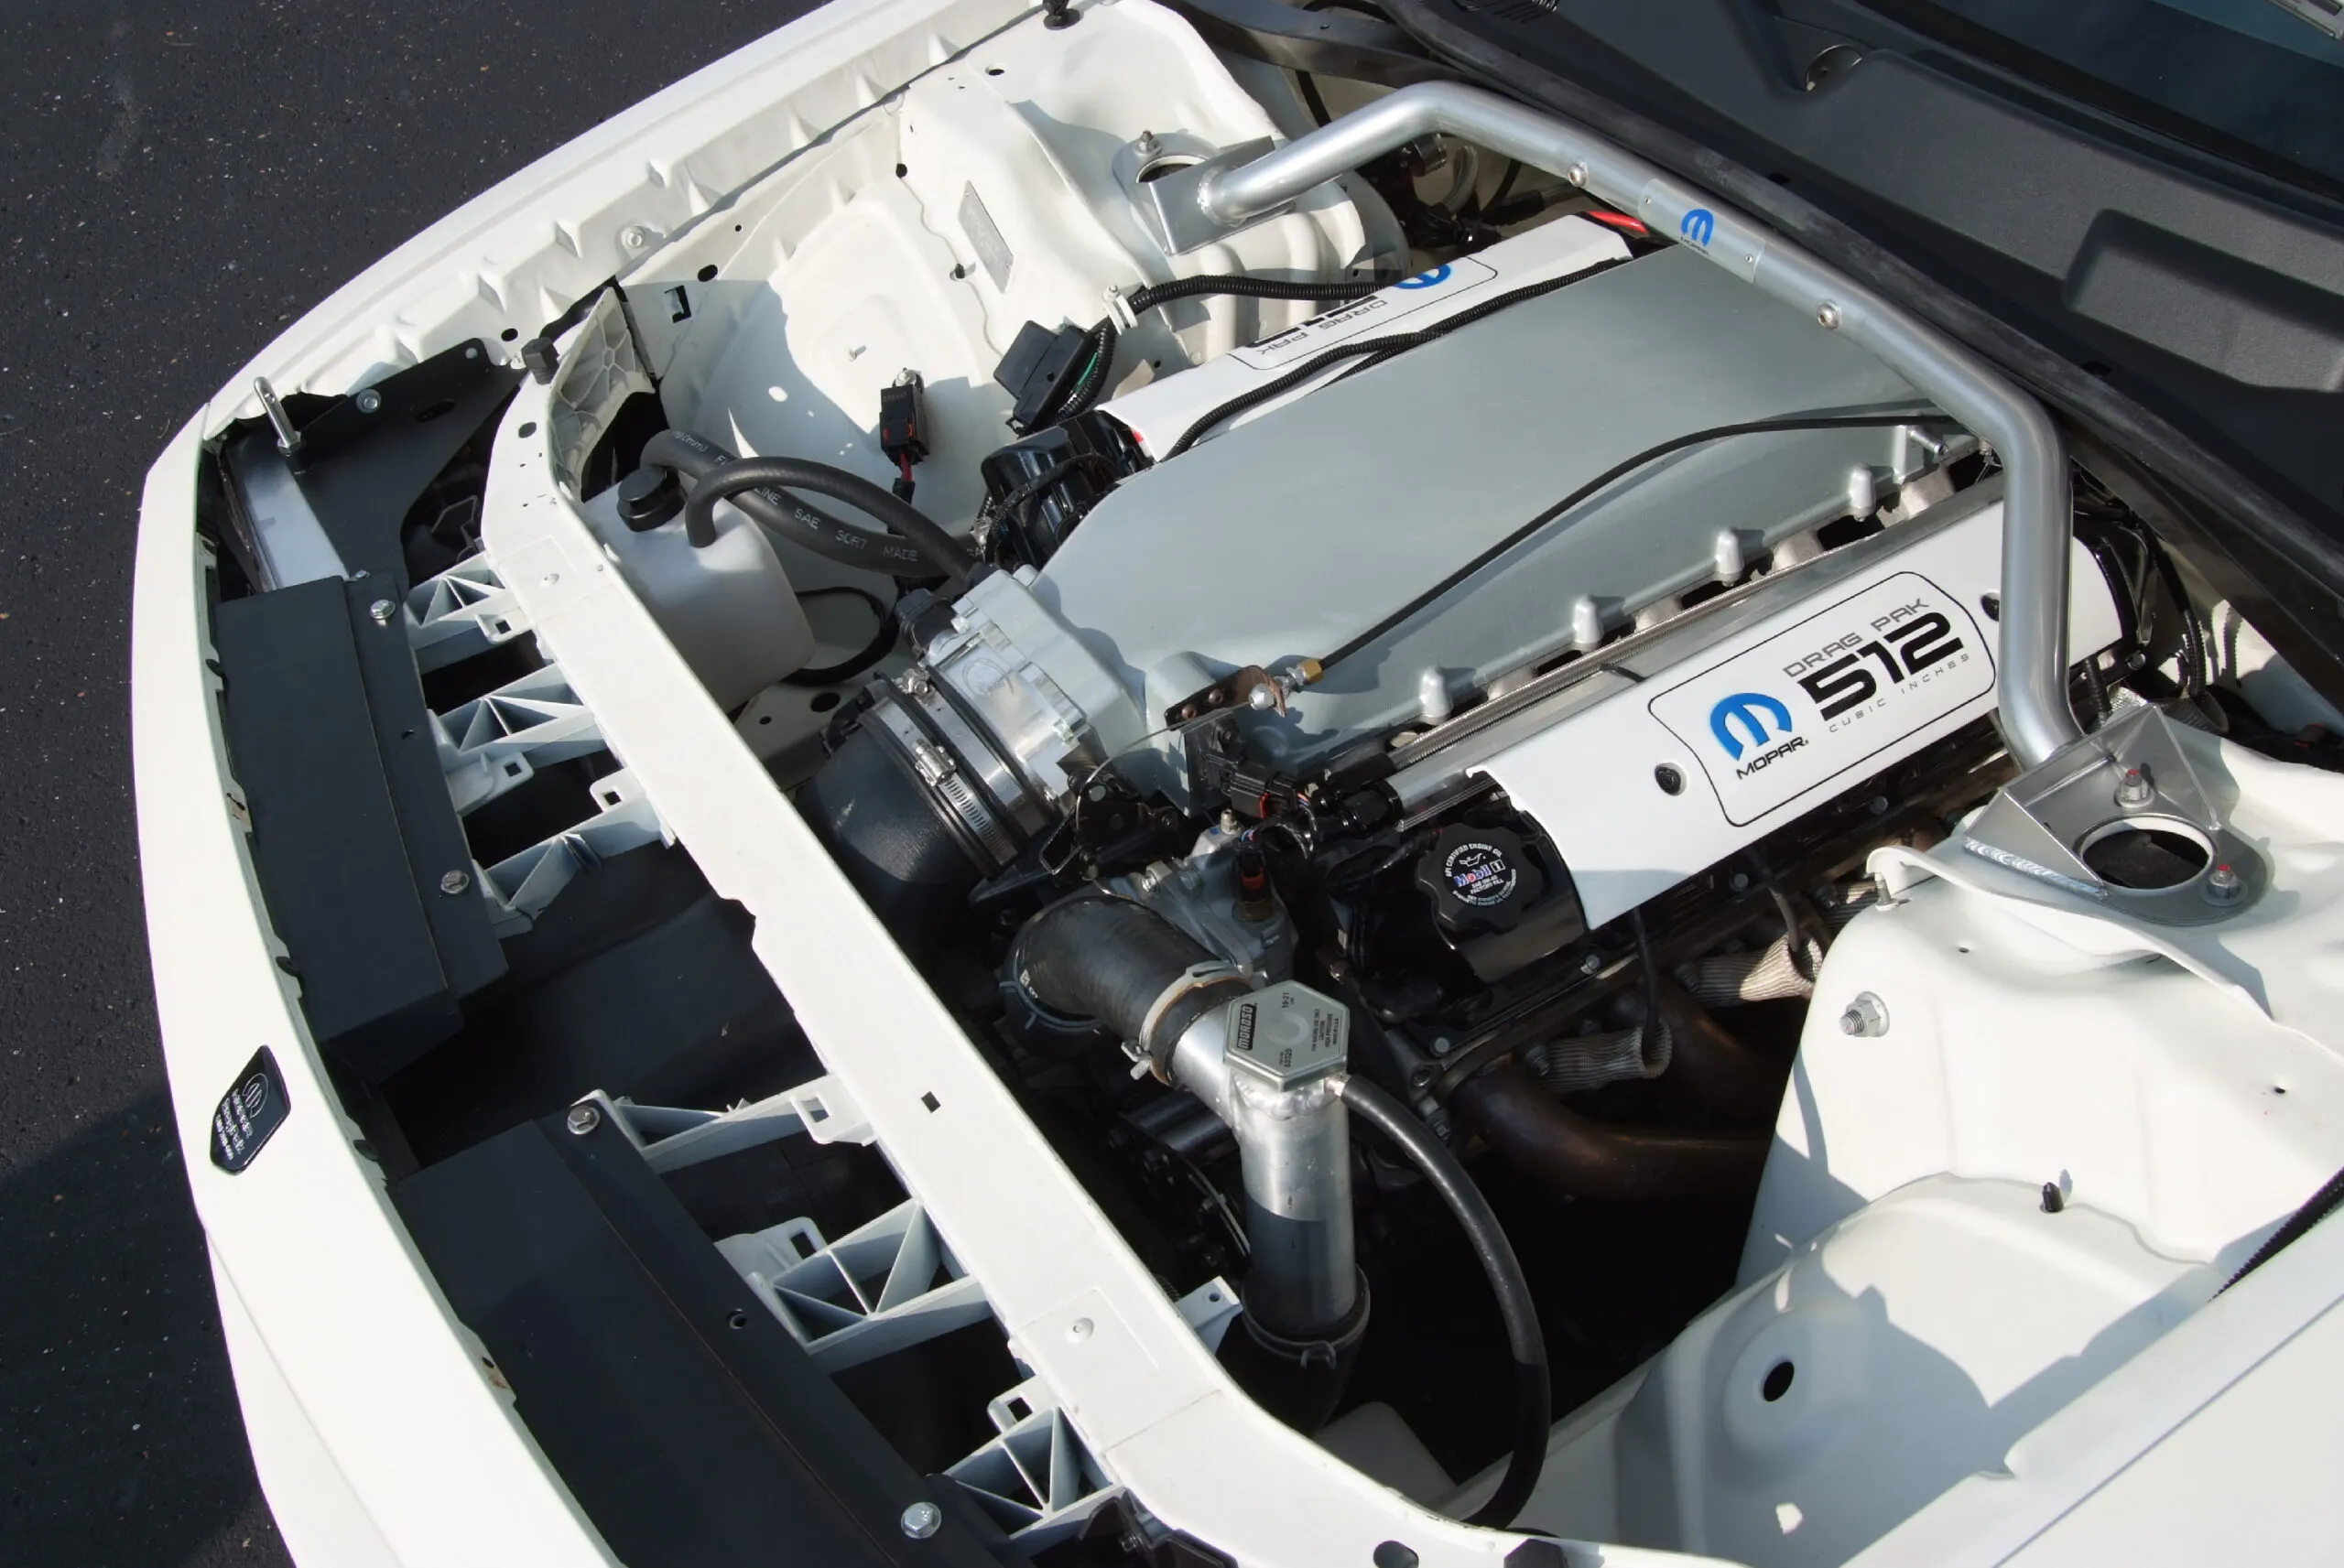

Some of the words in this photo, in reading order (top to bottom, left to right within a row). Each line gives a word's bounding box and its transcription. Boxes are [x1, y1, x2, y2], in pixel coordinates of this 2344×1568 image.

[1318, 299, 1389, 330] DRAG
[1253, 331, 1309, 355] PAK
[794, 508, 821, 530] SAE
[835, 529, 869, 551] 30R7
[883, 545, 918, 563] MADE
[1782, 632, 1863, 678] DRAG
[1870, 597, 1929, 632] PAK
[1796, 611, 1964, 722] 512
[1829, 697, 1888, 733] CUBIC
[1901, 653, 1970, 695] INCHES
[1453, 864, 1492, 888] Mobil
[1492, 848, 1503, 858] OIL
[1237, 1003, 1253, 1051] MOROSO
